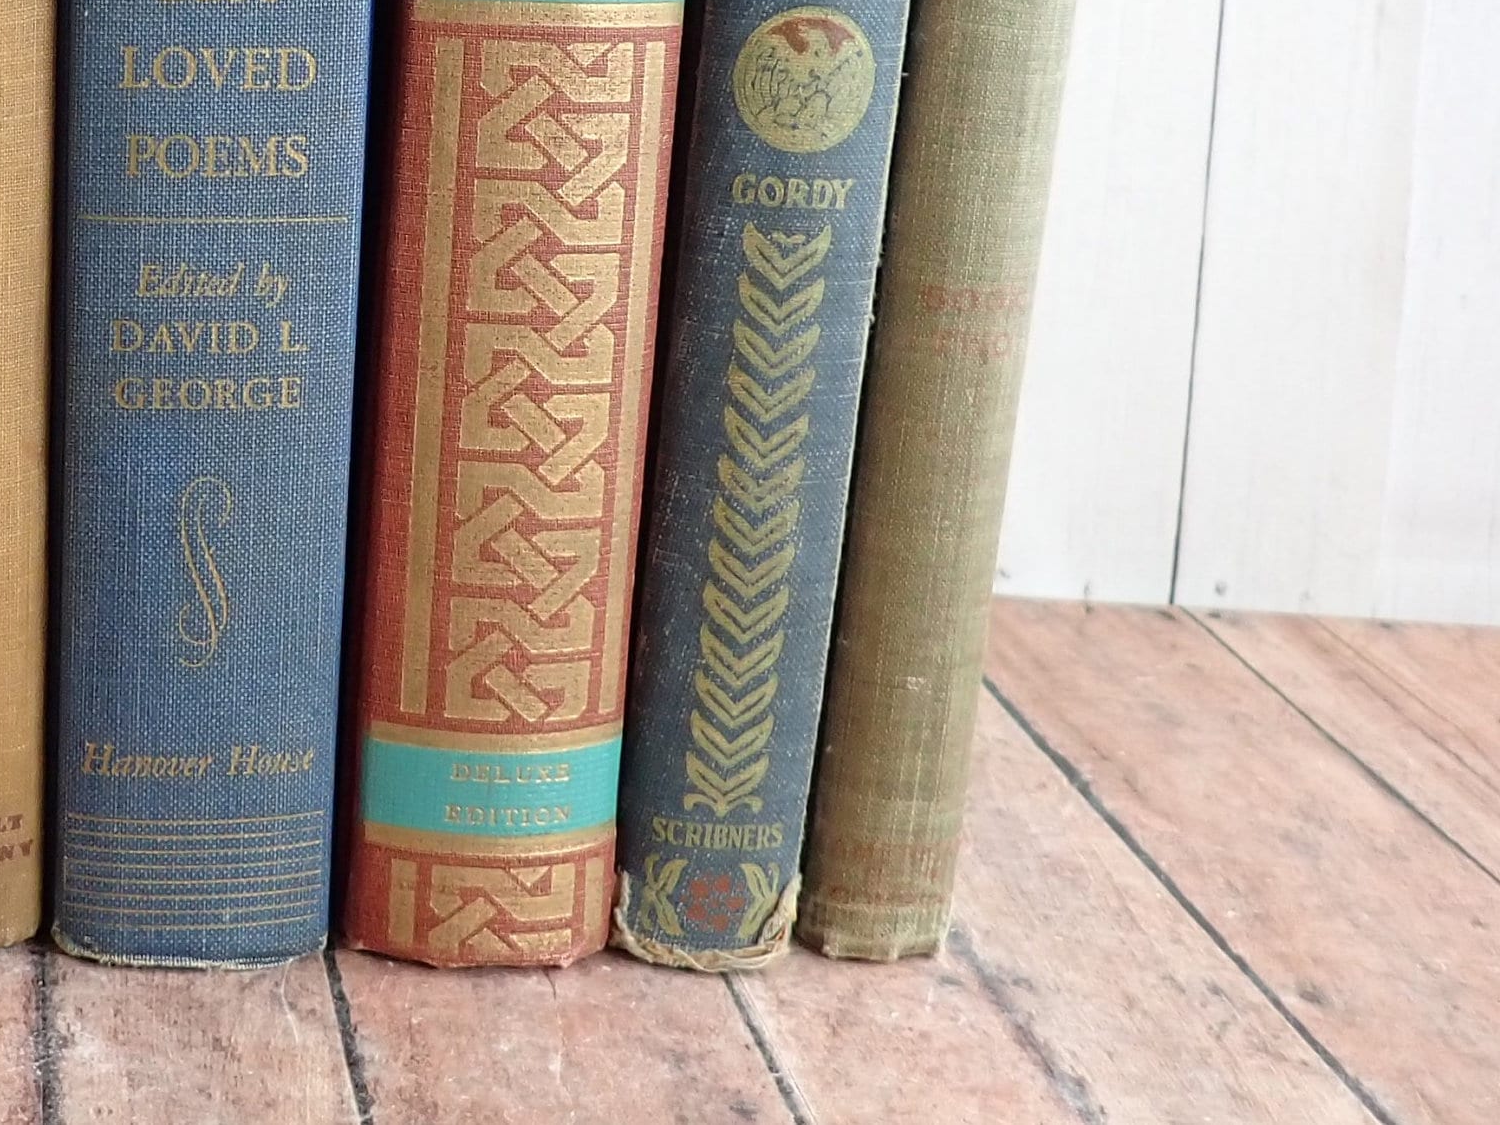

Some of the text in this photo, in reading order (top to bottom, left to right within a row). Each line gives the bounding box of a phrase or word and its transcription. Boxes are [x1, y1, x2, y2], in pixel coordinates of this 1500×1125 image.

[119, 45, 317, 91] LOVED
[127, 133, 310, 178] POEMS
[732, 174, 854, 210] GORDY
[135, 262, 289, 308] Edited by
[111, 319, 259, 354] DAVID
[114, 377, 303, 409] GEORGE
[82, 741, 314, 777] Hanover House
[450, 763, 571, 783] DELUXE
[443, 805, 572, 826] EDITION
[652, 816, 784, 851] SCRIBNERS
